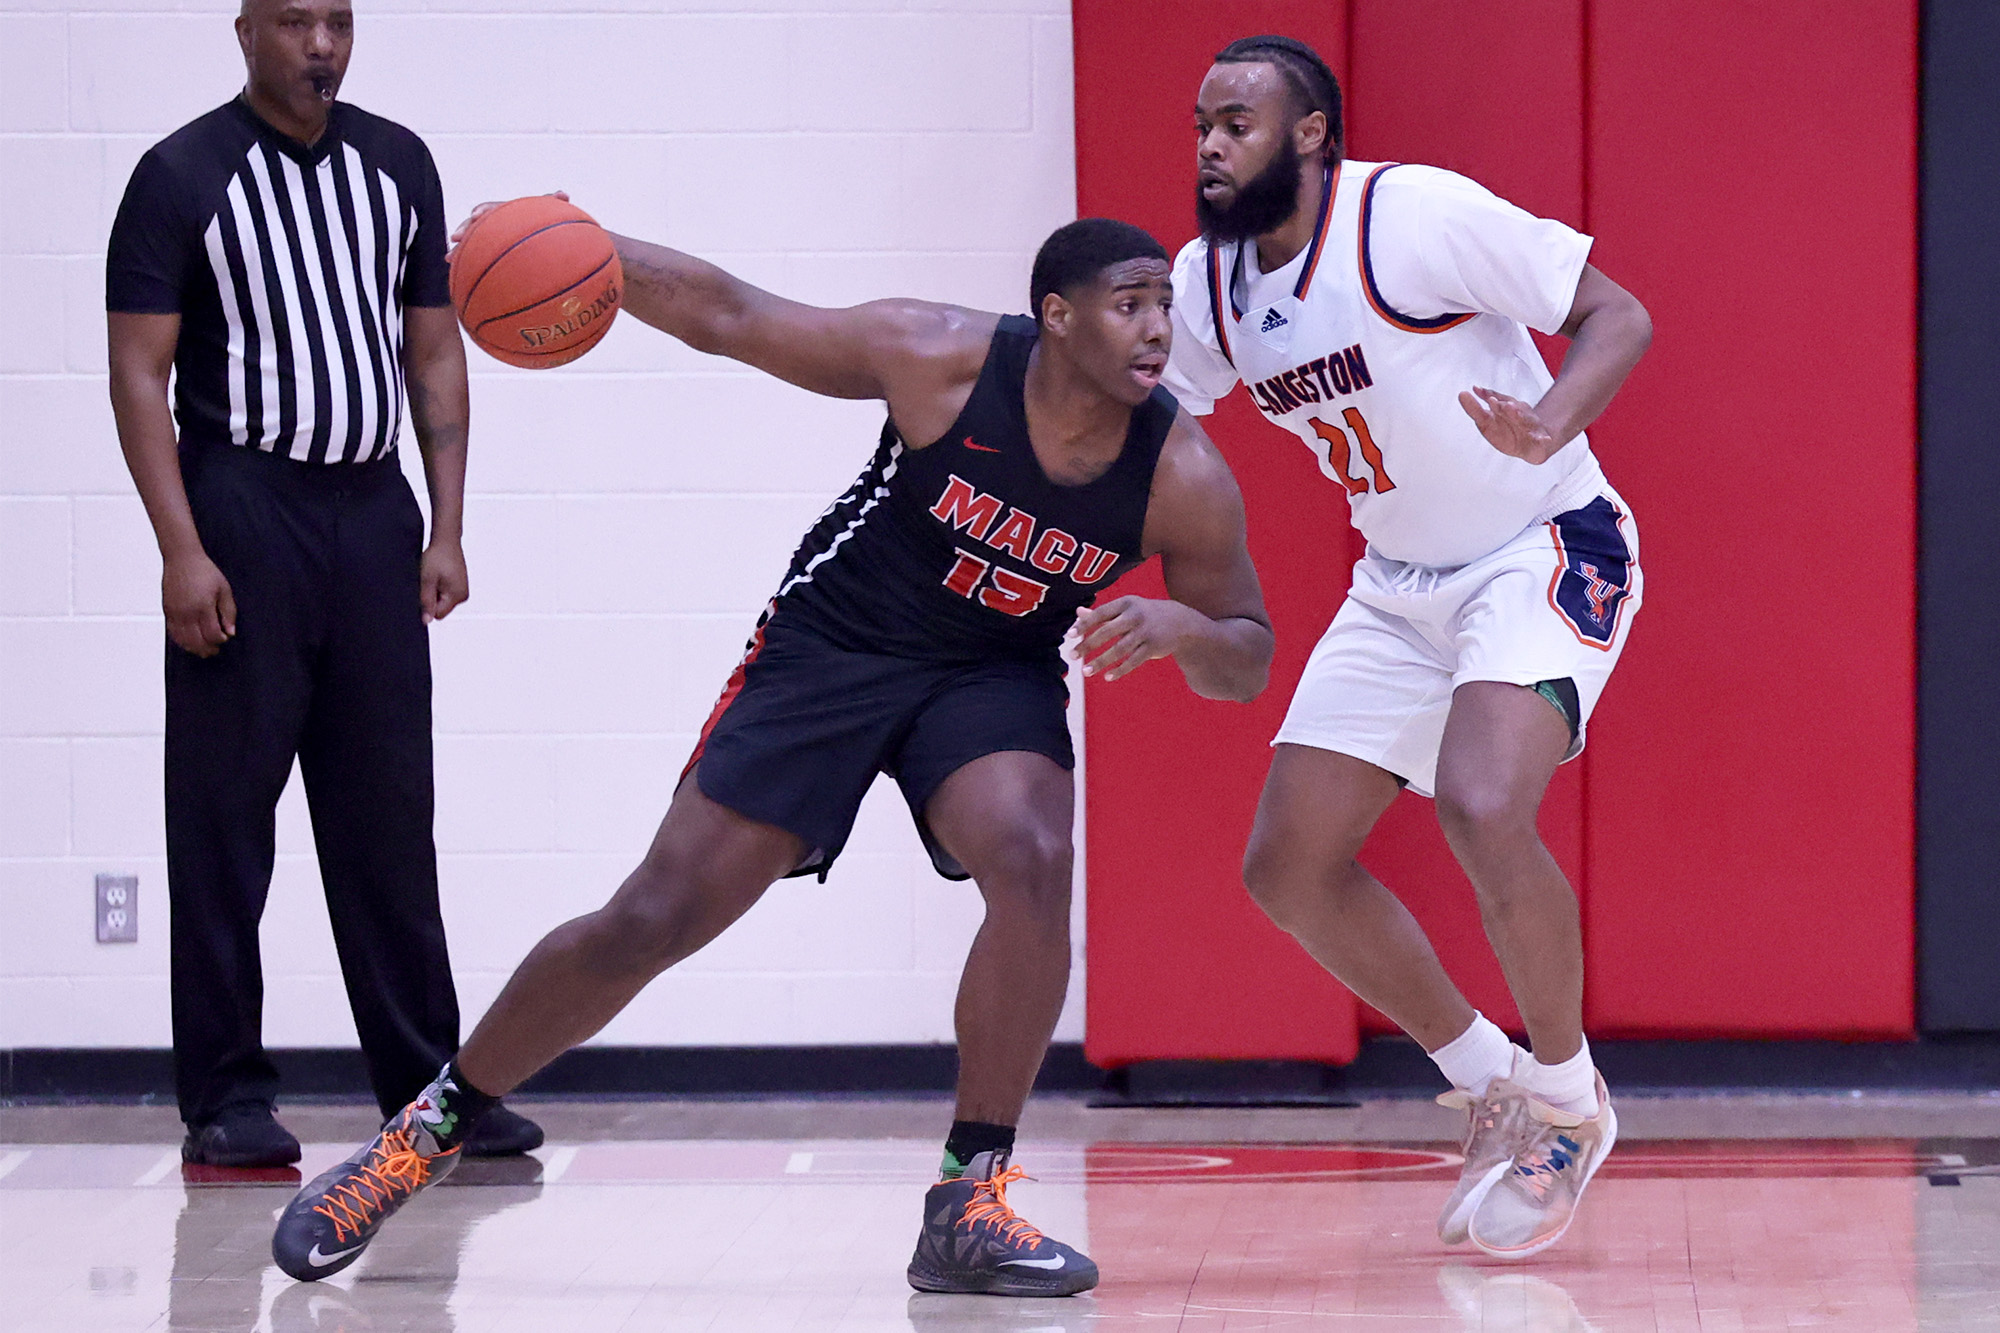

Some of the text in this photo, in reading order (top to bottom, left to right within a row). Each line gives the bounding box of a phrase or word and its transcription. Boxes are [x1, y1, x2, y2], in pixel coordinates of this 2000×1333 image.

[518, 279, 619, 350] SPALDING
[1261, 317, 1288, 333] adidas
[1307, 407, 1397, 496] 21
[929, 473, 1120, 584] MACU
[942, 547, 1050, 617] 15
